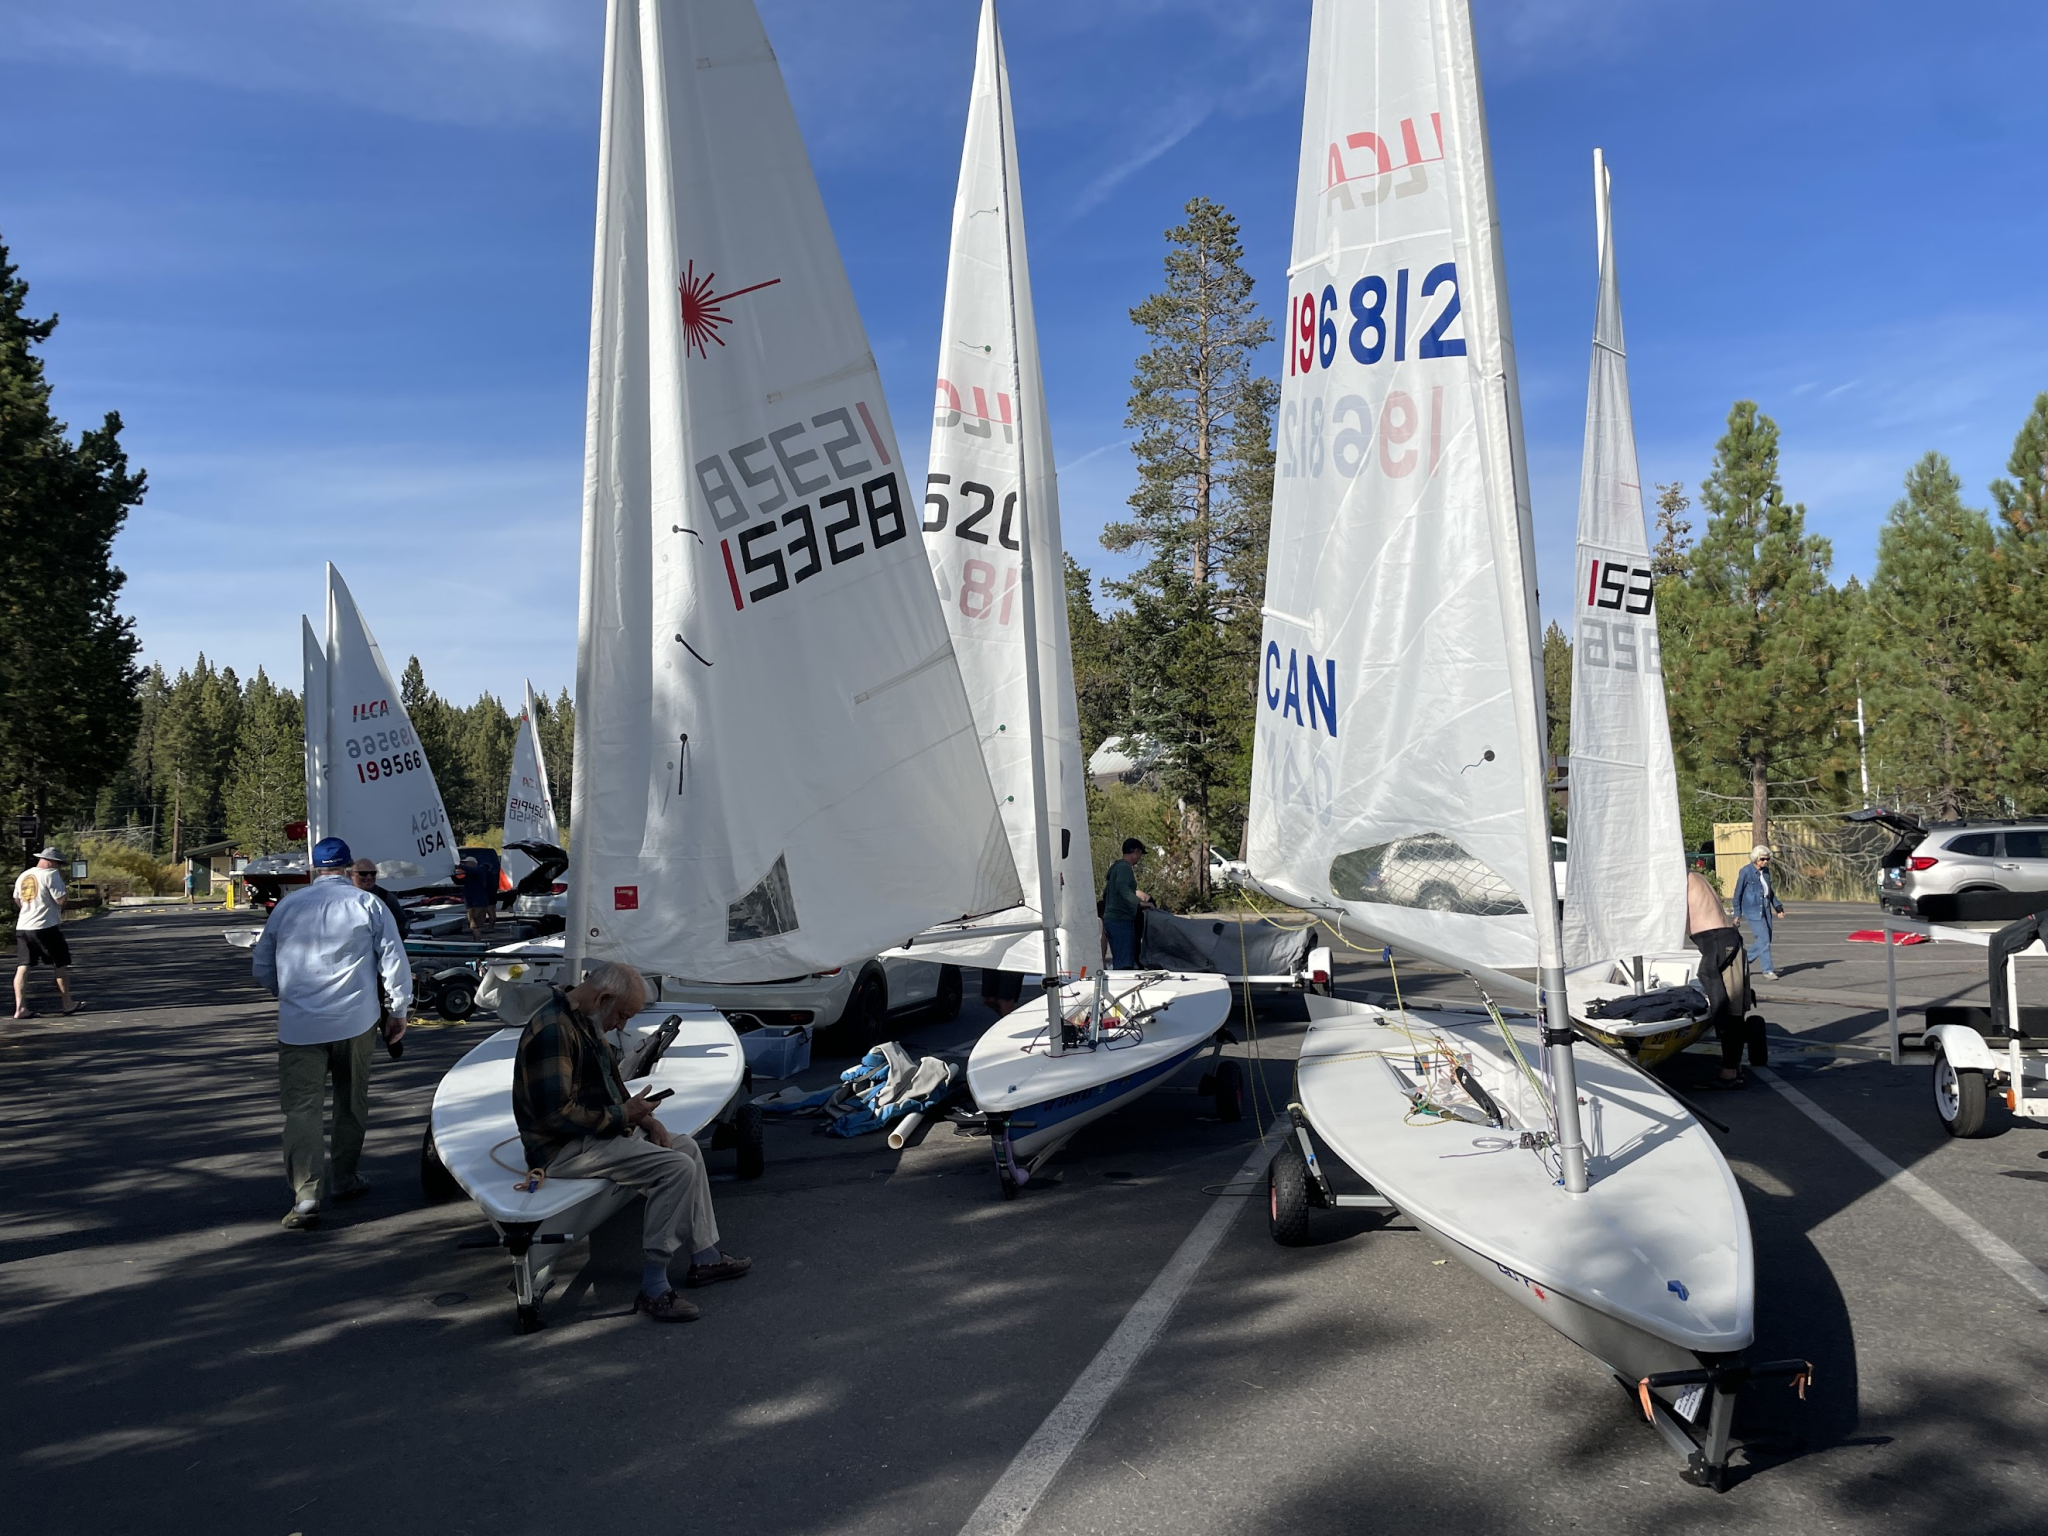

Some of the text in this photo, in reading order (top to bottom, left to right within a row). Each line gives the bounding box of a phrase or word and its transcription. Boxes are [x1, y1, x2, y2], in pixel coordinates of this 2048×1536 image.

[1290, 261, 1467, 376] 196812
[719, 471, 907, 612] 15328
[352, 699, 390, 723] ILCA
[1265, 640, 1338, 738] CAN
[357, 749, 422, 784] 199566
[416, 830, 446, 857] USA
